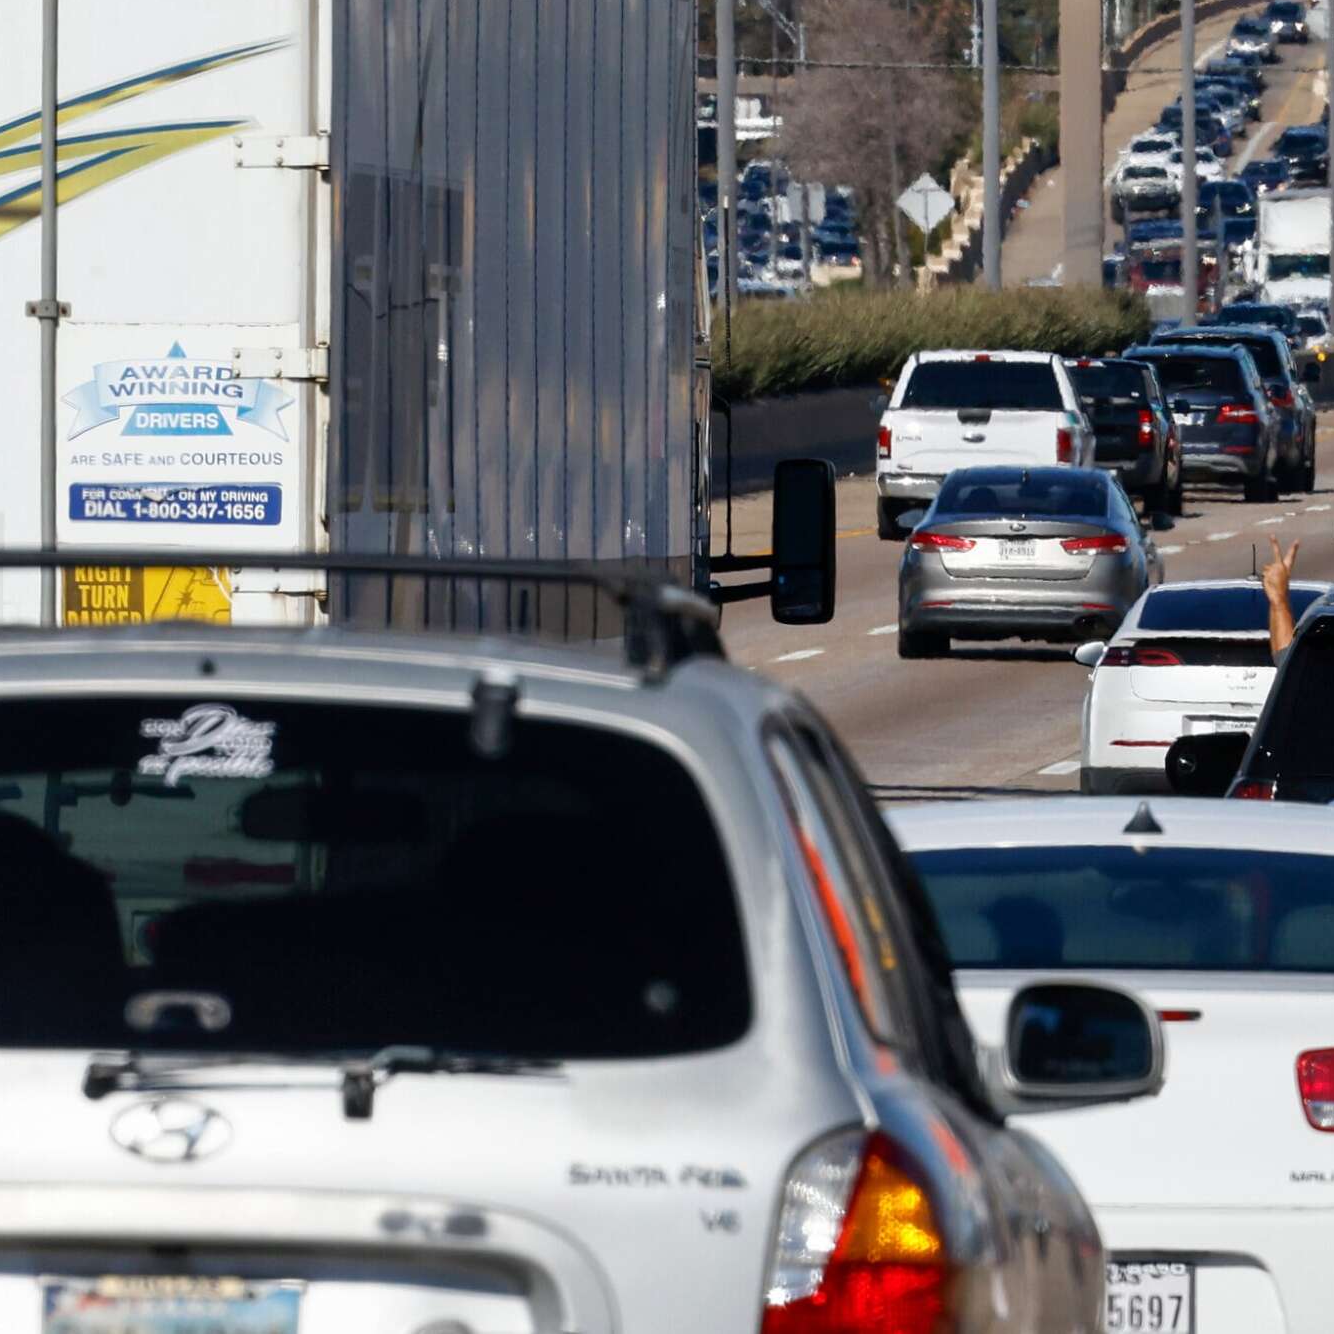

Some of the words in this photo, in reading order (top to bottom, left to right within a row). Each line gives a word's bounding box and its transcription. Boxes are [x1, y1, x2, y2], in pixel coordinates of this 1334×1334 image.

[120, 365, 234, 381] AWARD
[108, 381, 244, 399] WINNING
[135, 413, 219, 429] DRIVERS
[71, 455, 97, 466] ARE
[101, 452, 143, 466] SAFE
[148, 455, 175, 466] AND
[179, 452, 283, 466] COURTEOUS
[82, 488, 106, 501] FOR
[178, 489, 196, 501] ON
[200, 490, 217, 502] MY
[220, 490, 269, 503] DRIVING
[84, 500, 127, 518] DIAL
[132, 502, 265, 520] 1-800-347-1656
[74, 566, 132, 582] RIGHT
[78, 584, 130, 609] TURN
